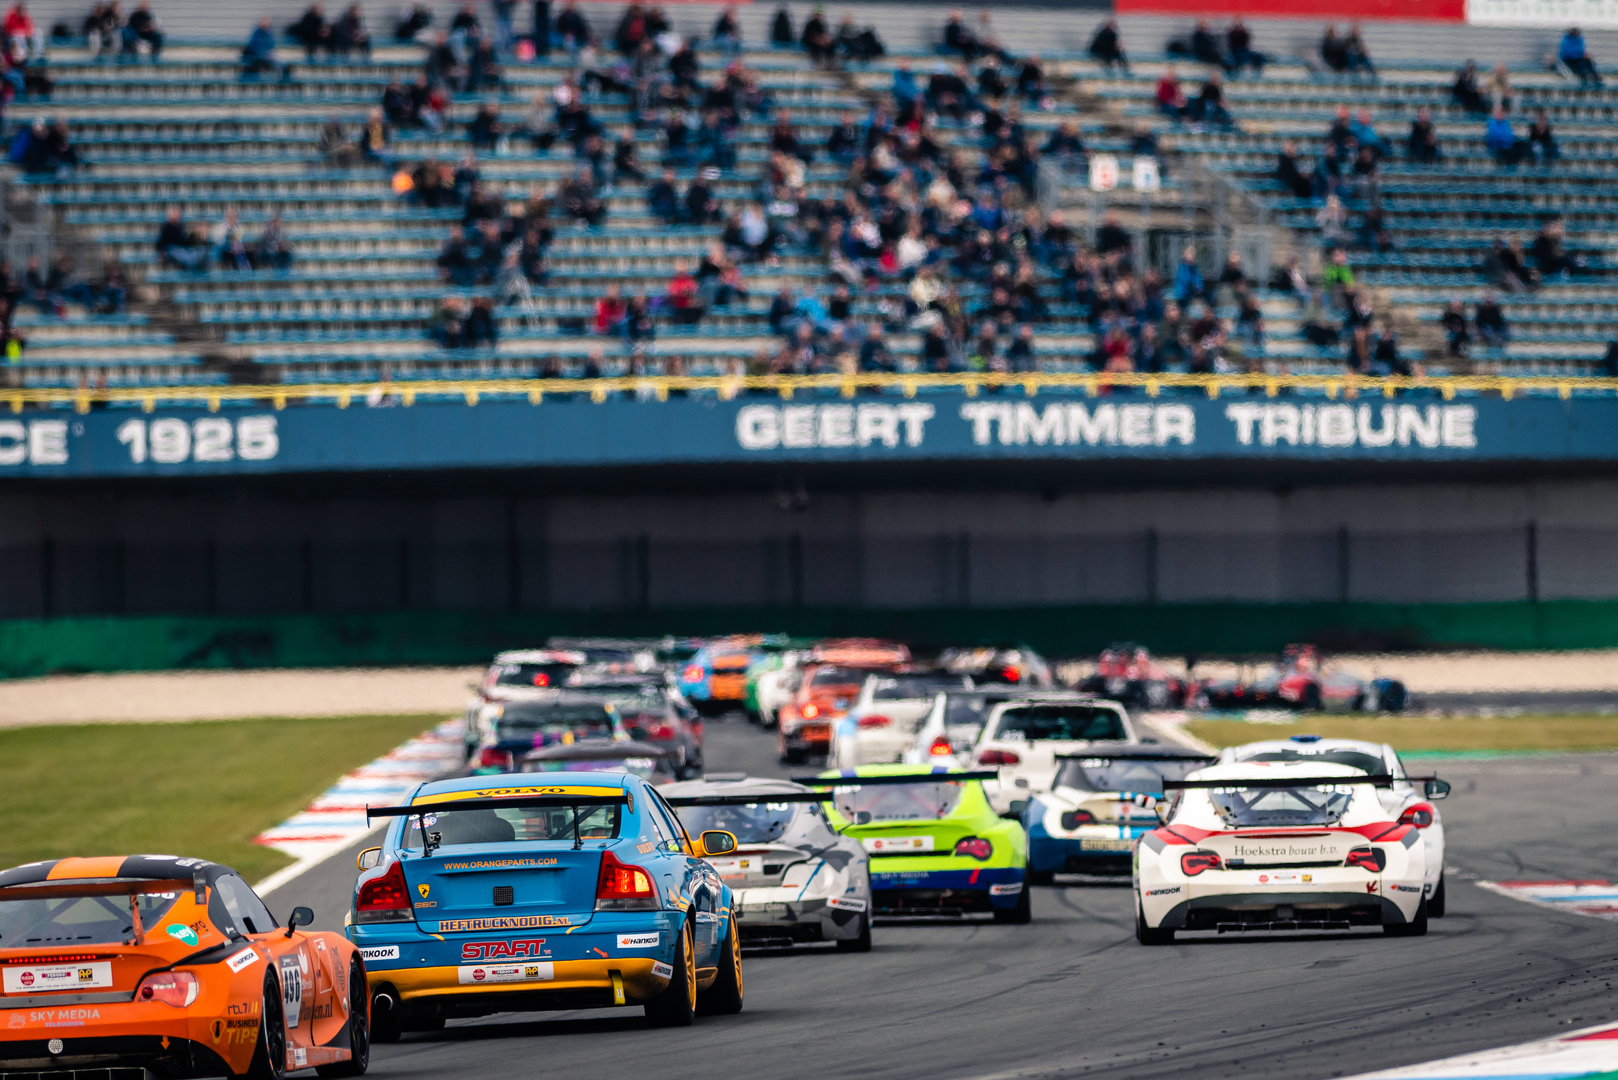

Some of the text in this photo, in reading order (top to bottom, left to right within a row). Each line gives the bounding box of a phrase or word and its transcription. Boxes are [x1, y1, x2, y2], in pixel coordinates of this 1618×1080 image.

[736, 401, 1478, 449] GEERT TIMMER TRIBUNE
[117, 414, 280, 464] 1925
[475, 787, 565, 796] VOLVO
[1234, 844, 1339, 857] Hoekstra bouw b.v.
[444, 858, 558, 870] WWW.ORANGEPARTS.COM
[414, 901, 438, 909] S60
[439, 915, 571, 933] HEFTRUCKNODIG.NL
[461, 938, 546, 959] START
[284, 968, 301, 1004] 496
[30, 1009, 100, 1022] SKY MEDIA
[227, 1019, 259, 1029] BUSINESS
[226, 1028, 258, 1045] TIPS
